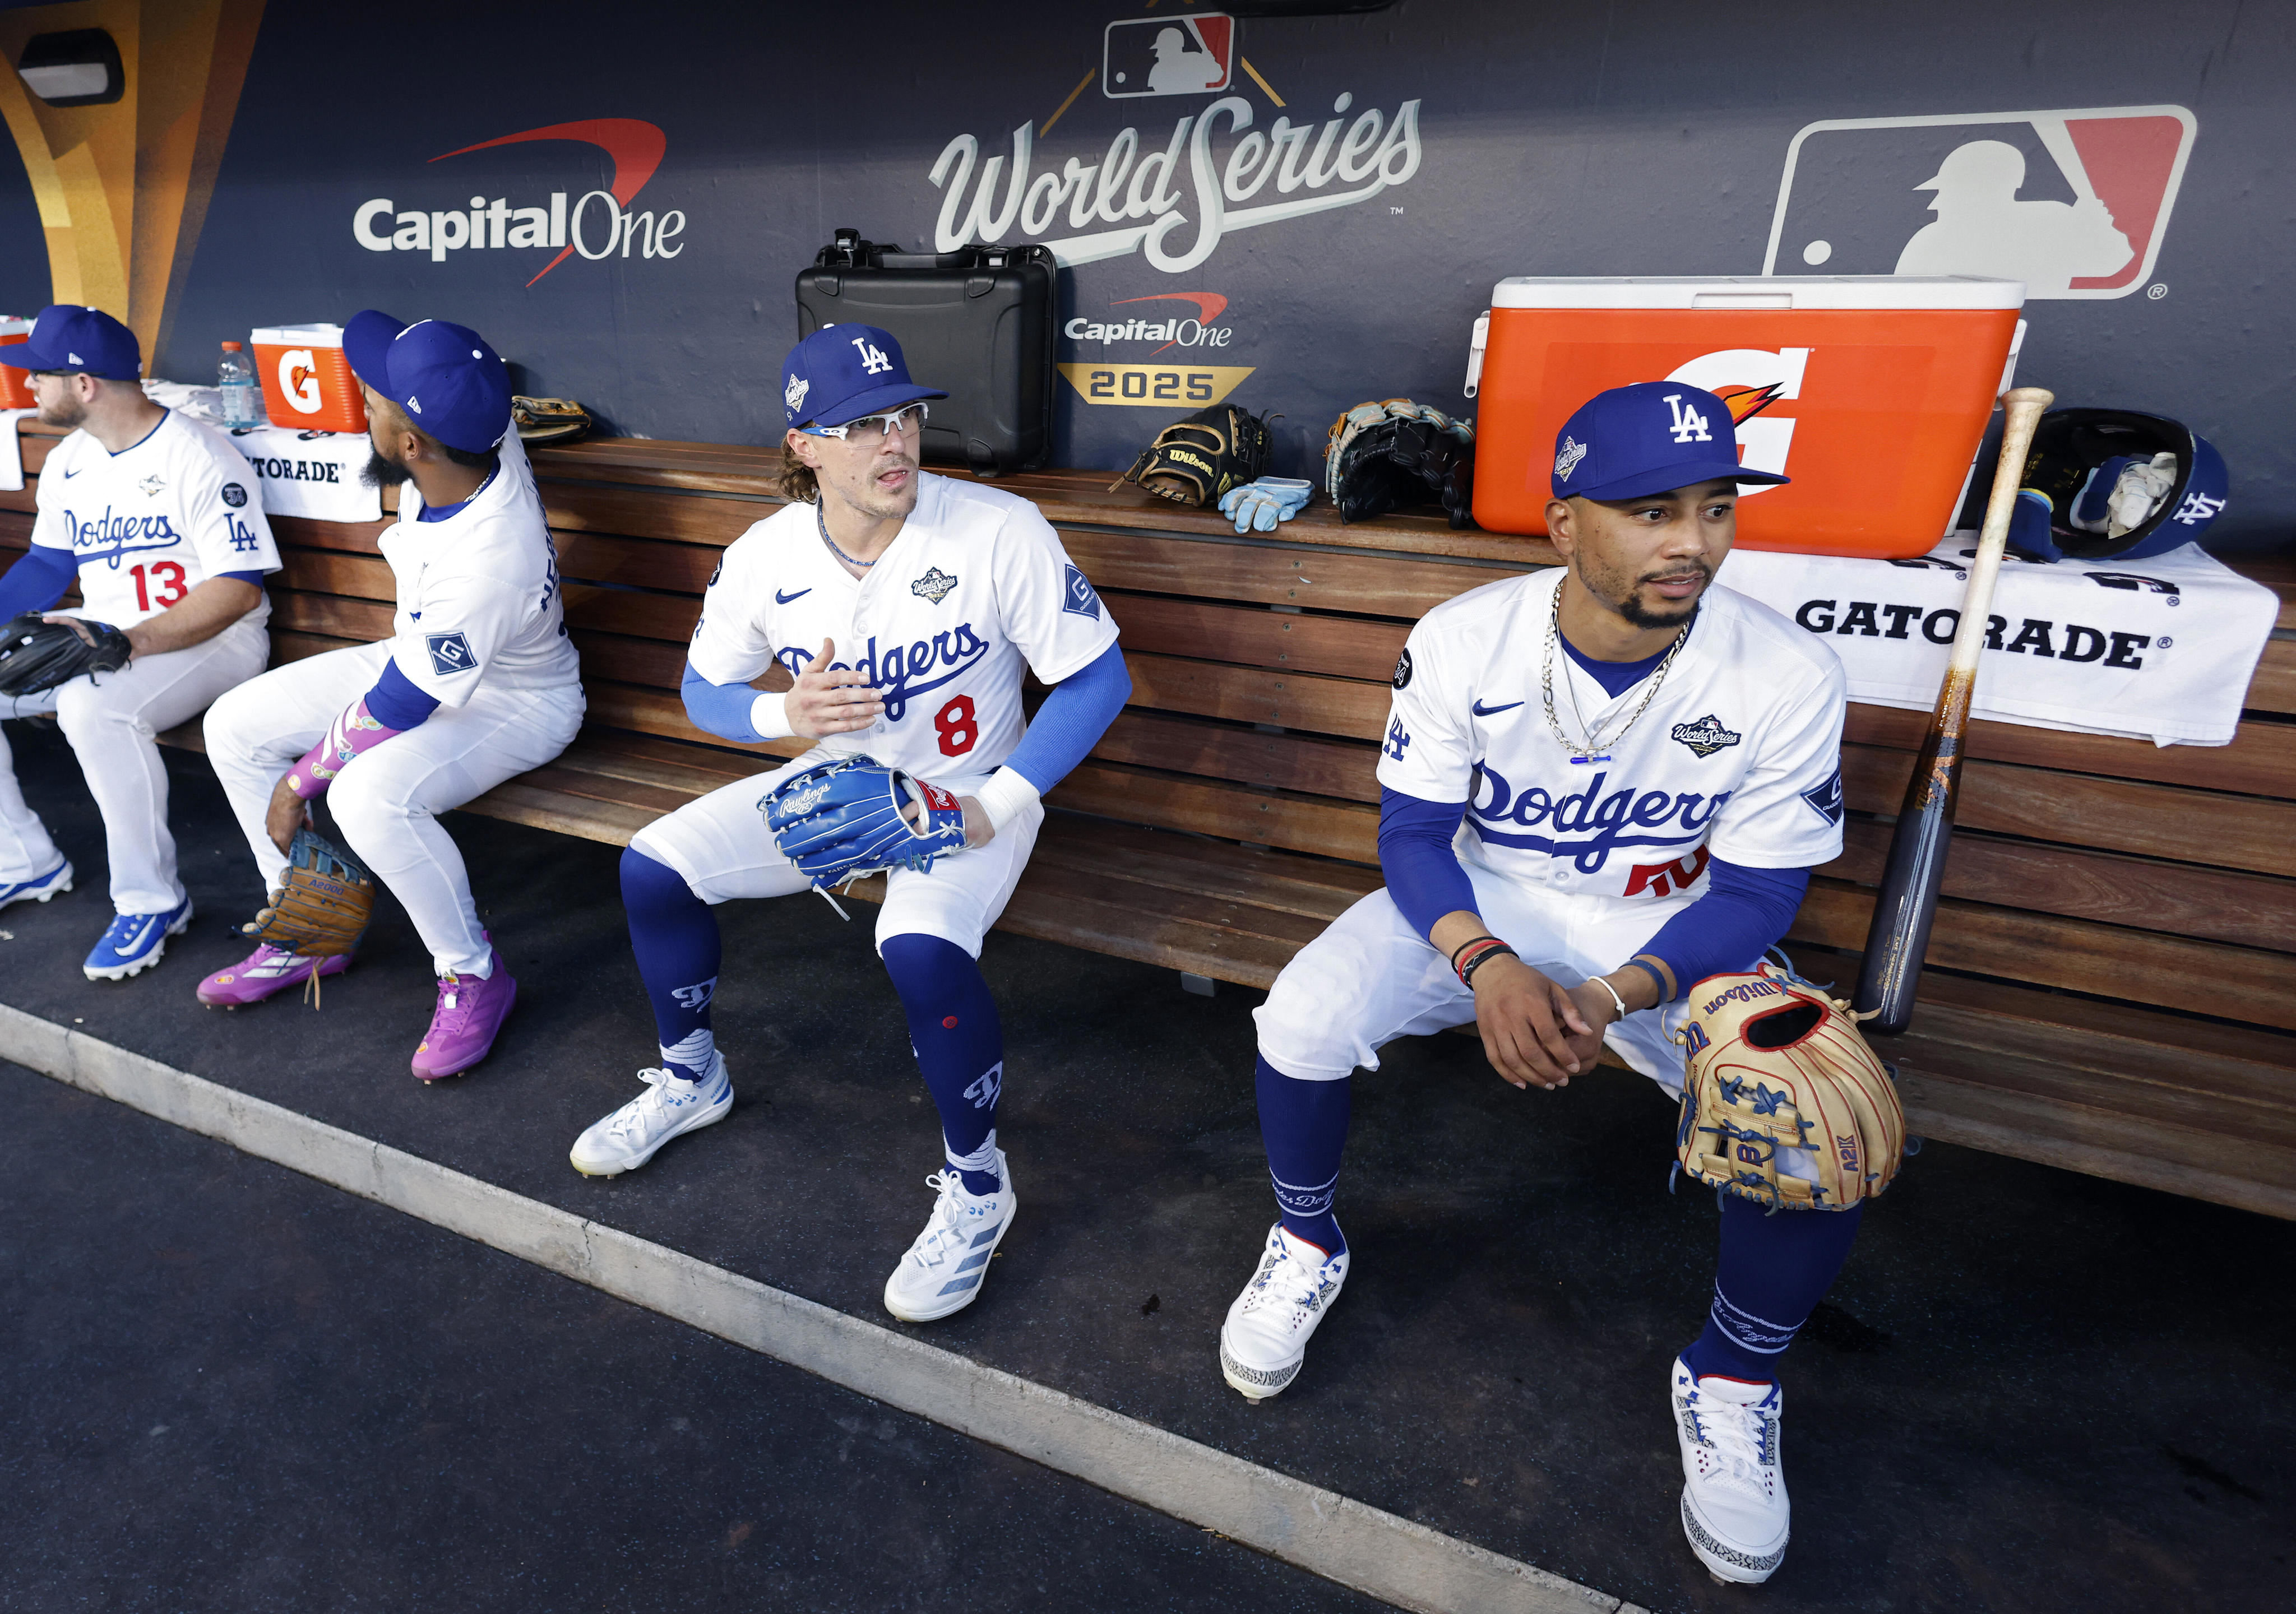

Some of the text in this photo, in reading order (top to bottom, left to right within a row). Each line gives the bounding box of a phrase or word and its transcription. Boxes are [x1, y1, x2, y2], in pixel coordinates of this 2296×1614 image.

[928, 91, 1422, 273] World Series
[851, 337, 894, 376] LA
[279, 350, 322, 414] G
[1090, 371, 1214, 400] 2025
[1662, 393, 1713, 444] LA
[244, 456, 339, 483] TORADE
[1170, 449, 1213, 477] Wilson
[2173, 491, 2226, 526] LA
[224, 513, 258, 551] LA
[129, 561, 188, 611] 13
[440, 640, 464, 661] G
[1795, 599, 2151, 671] GATORADE
[934, 694, 978, 757] 8
[1674, 725, 1738, 746] World Series
[780, 783, 831, 818] Rawlings
[309, 879, 345, 896] A2000
[1702, 981, 1778, 1016] Wilson
[1836, 1134, 1859, 1172] A2K
